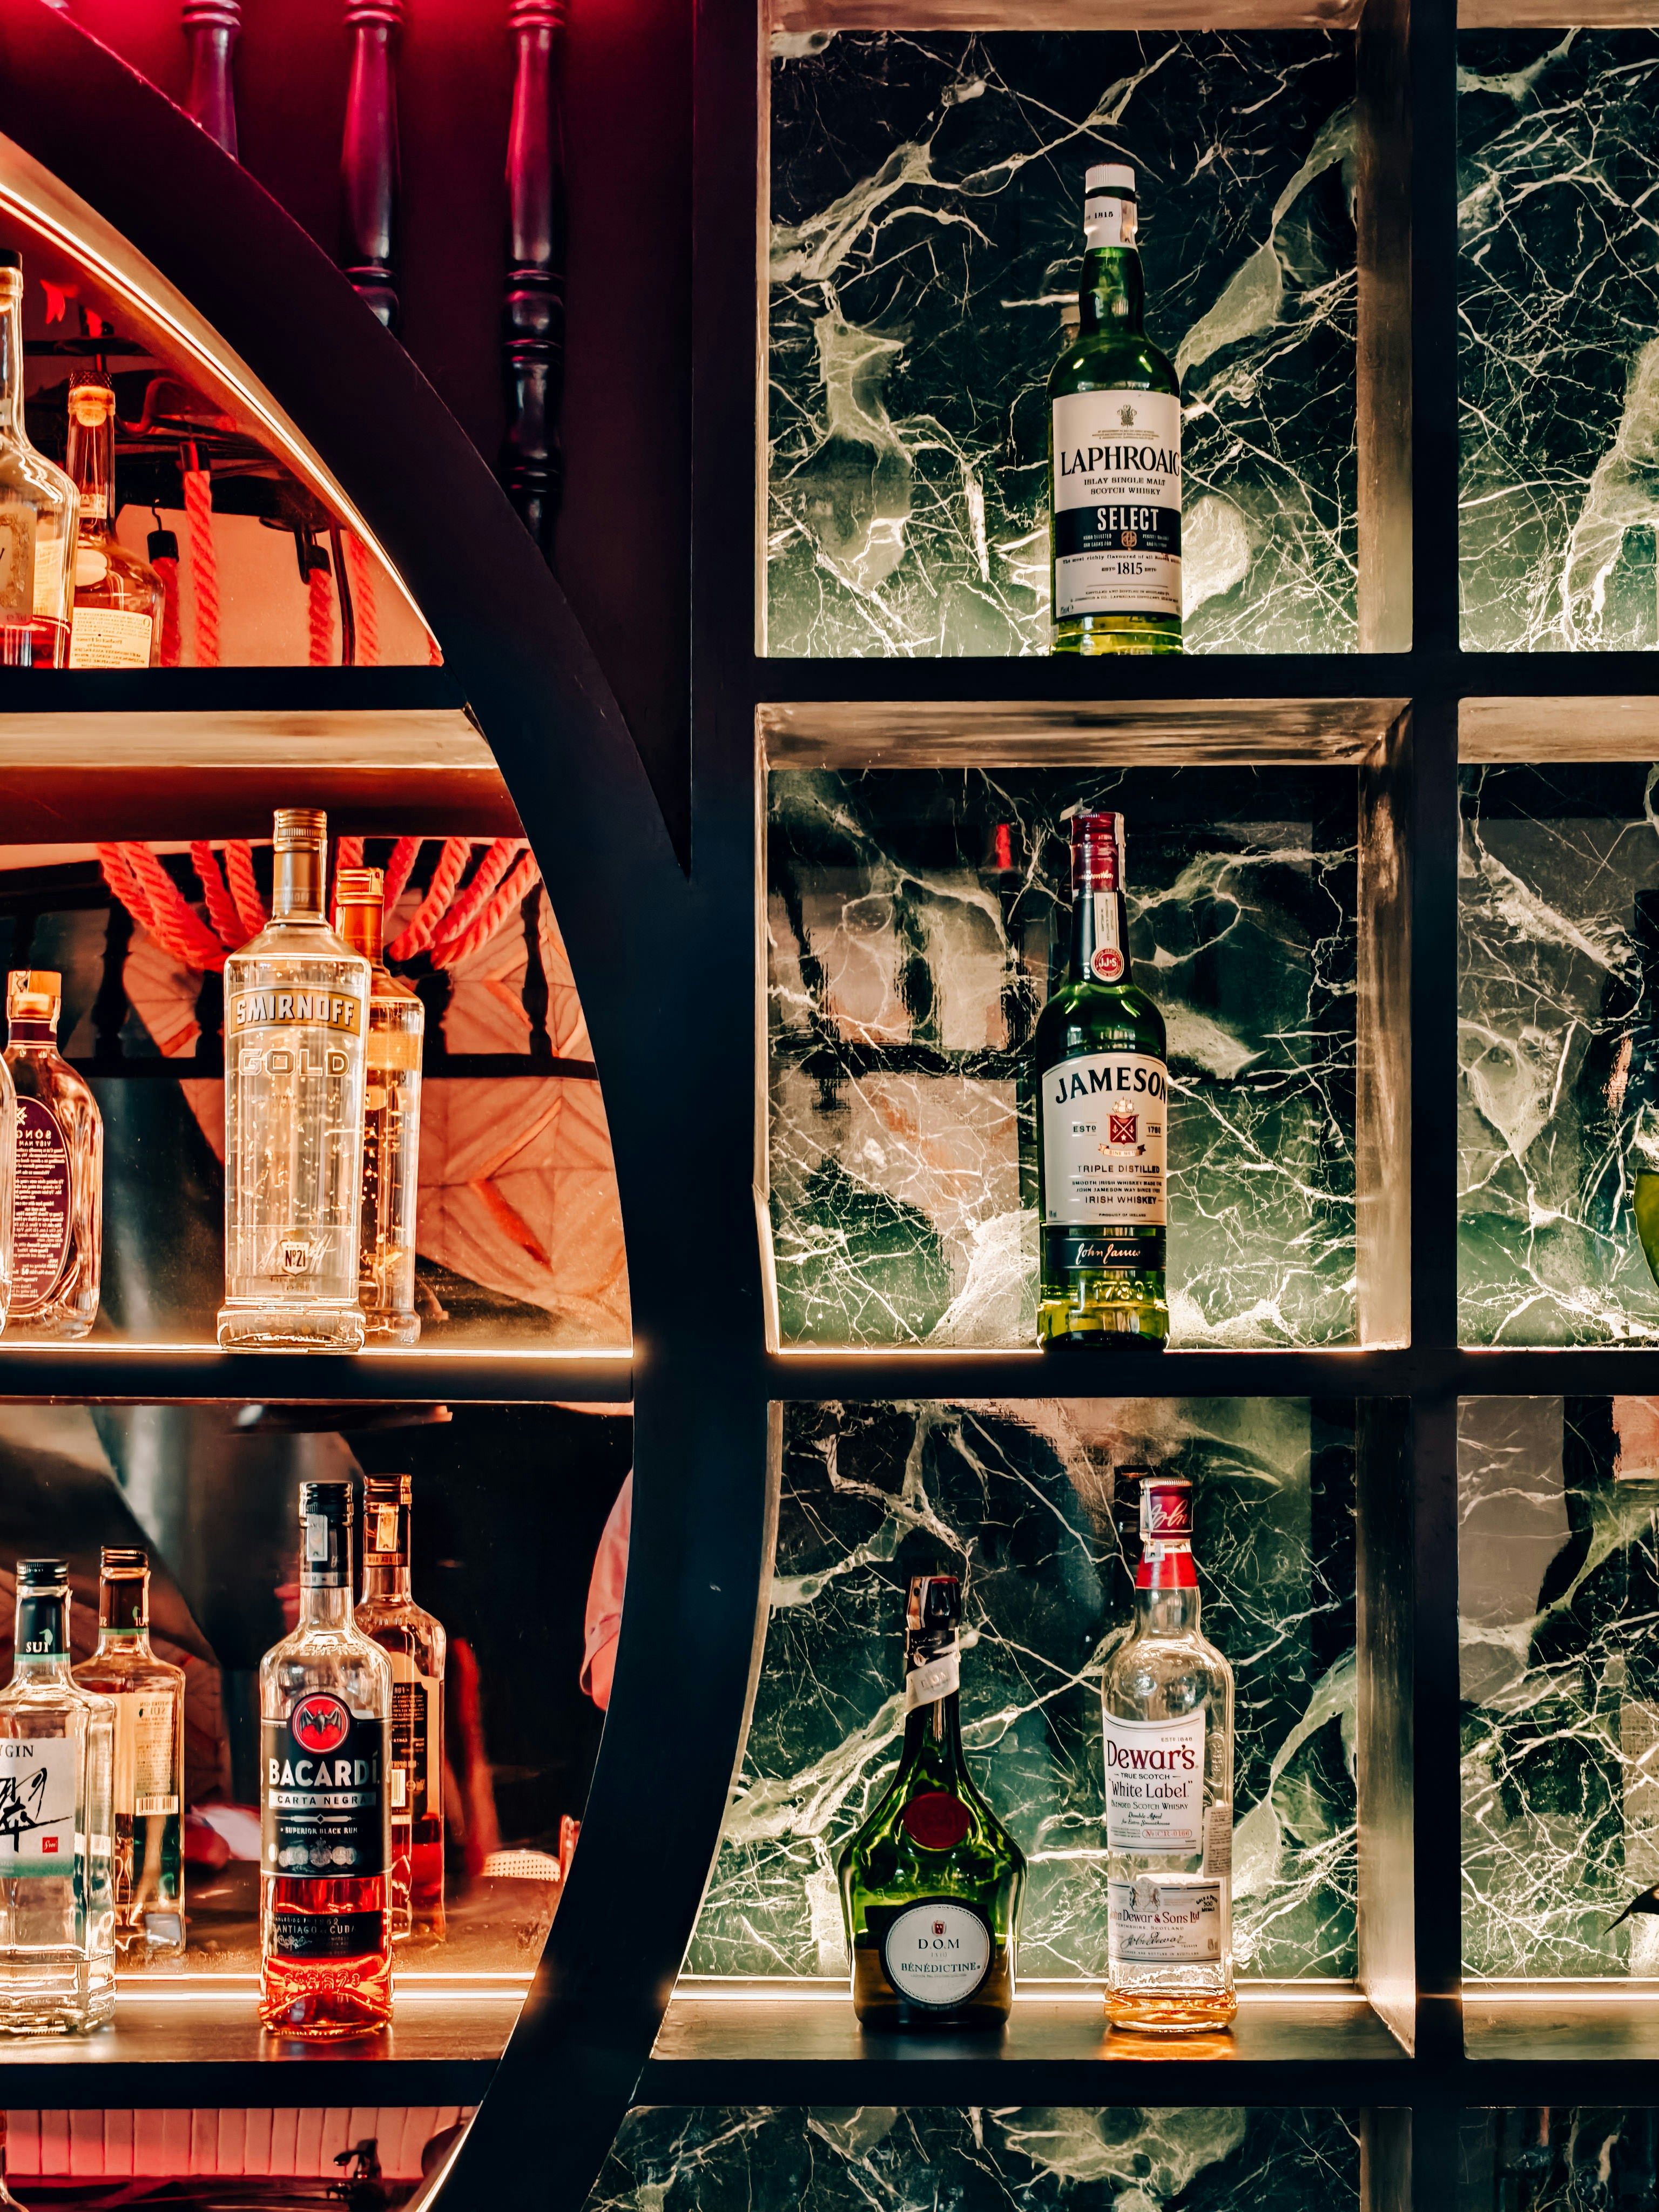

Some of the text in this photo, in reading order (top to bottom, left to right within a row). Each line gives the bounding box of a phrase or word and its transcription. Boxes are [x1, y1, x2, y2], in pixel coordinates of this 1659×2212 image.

[1061, 446, 1180, 476] LAPHROAIG
[1084, 477, 1109, 485] ISLAY
[1147, 477, 1165, 486] MALT
[1091, 487, 1161, 495] SCOTCH WHISKY
[1097, 507, 1159, 531] SELECT
[1117, 562, 1143, 575] 1815
[237, 995, 354, 1026] SMIRNOFF
[239, 1048, 349, 1077] GOLD
[1056, 1067, 1166, 1104] JAMESON
[1077, 1165, 1160, 1174] TRIPLE DISTILLED
[1117, 1196, 1157, 1204] WHISKEY
[26, 1641, 49, 1653] SUI
[1107, 1739, 1195, 1770] Dewar's
[278, 1795, 367, 1805] CARTA NEGRA
[285, 1826, 318, 1835] SUPERIOR
[1123, 1909, 1152, 1923] Dewar
[1154, 1913, 1161, 1923] &
[1162, 1911, 1188, 1924] Sons
[1190, 1911, 1199, 1924] Ltd
[901, 1962, 976, 1972] BÉNÉDICTINE
